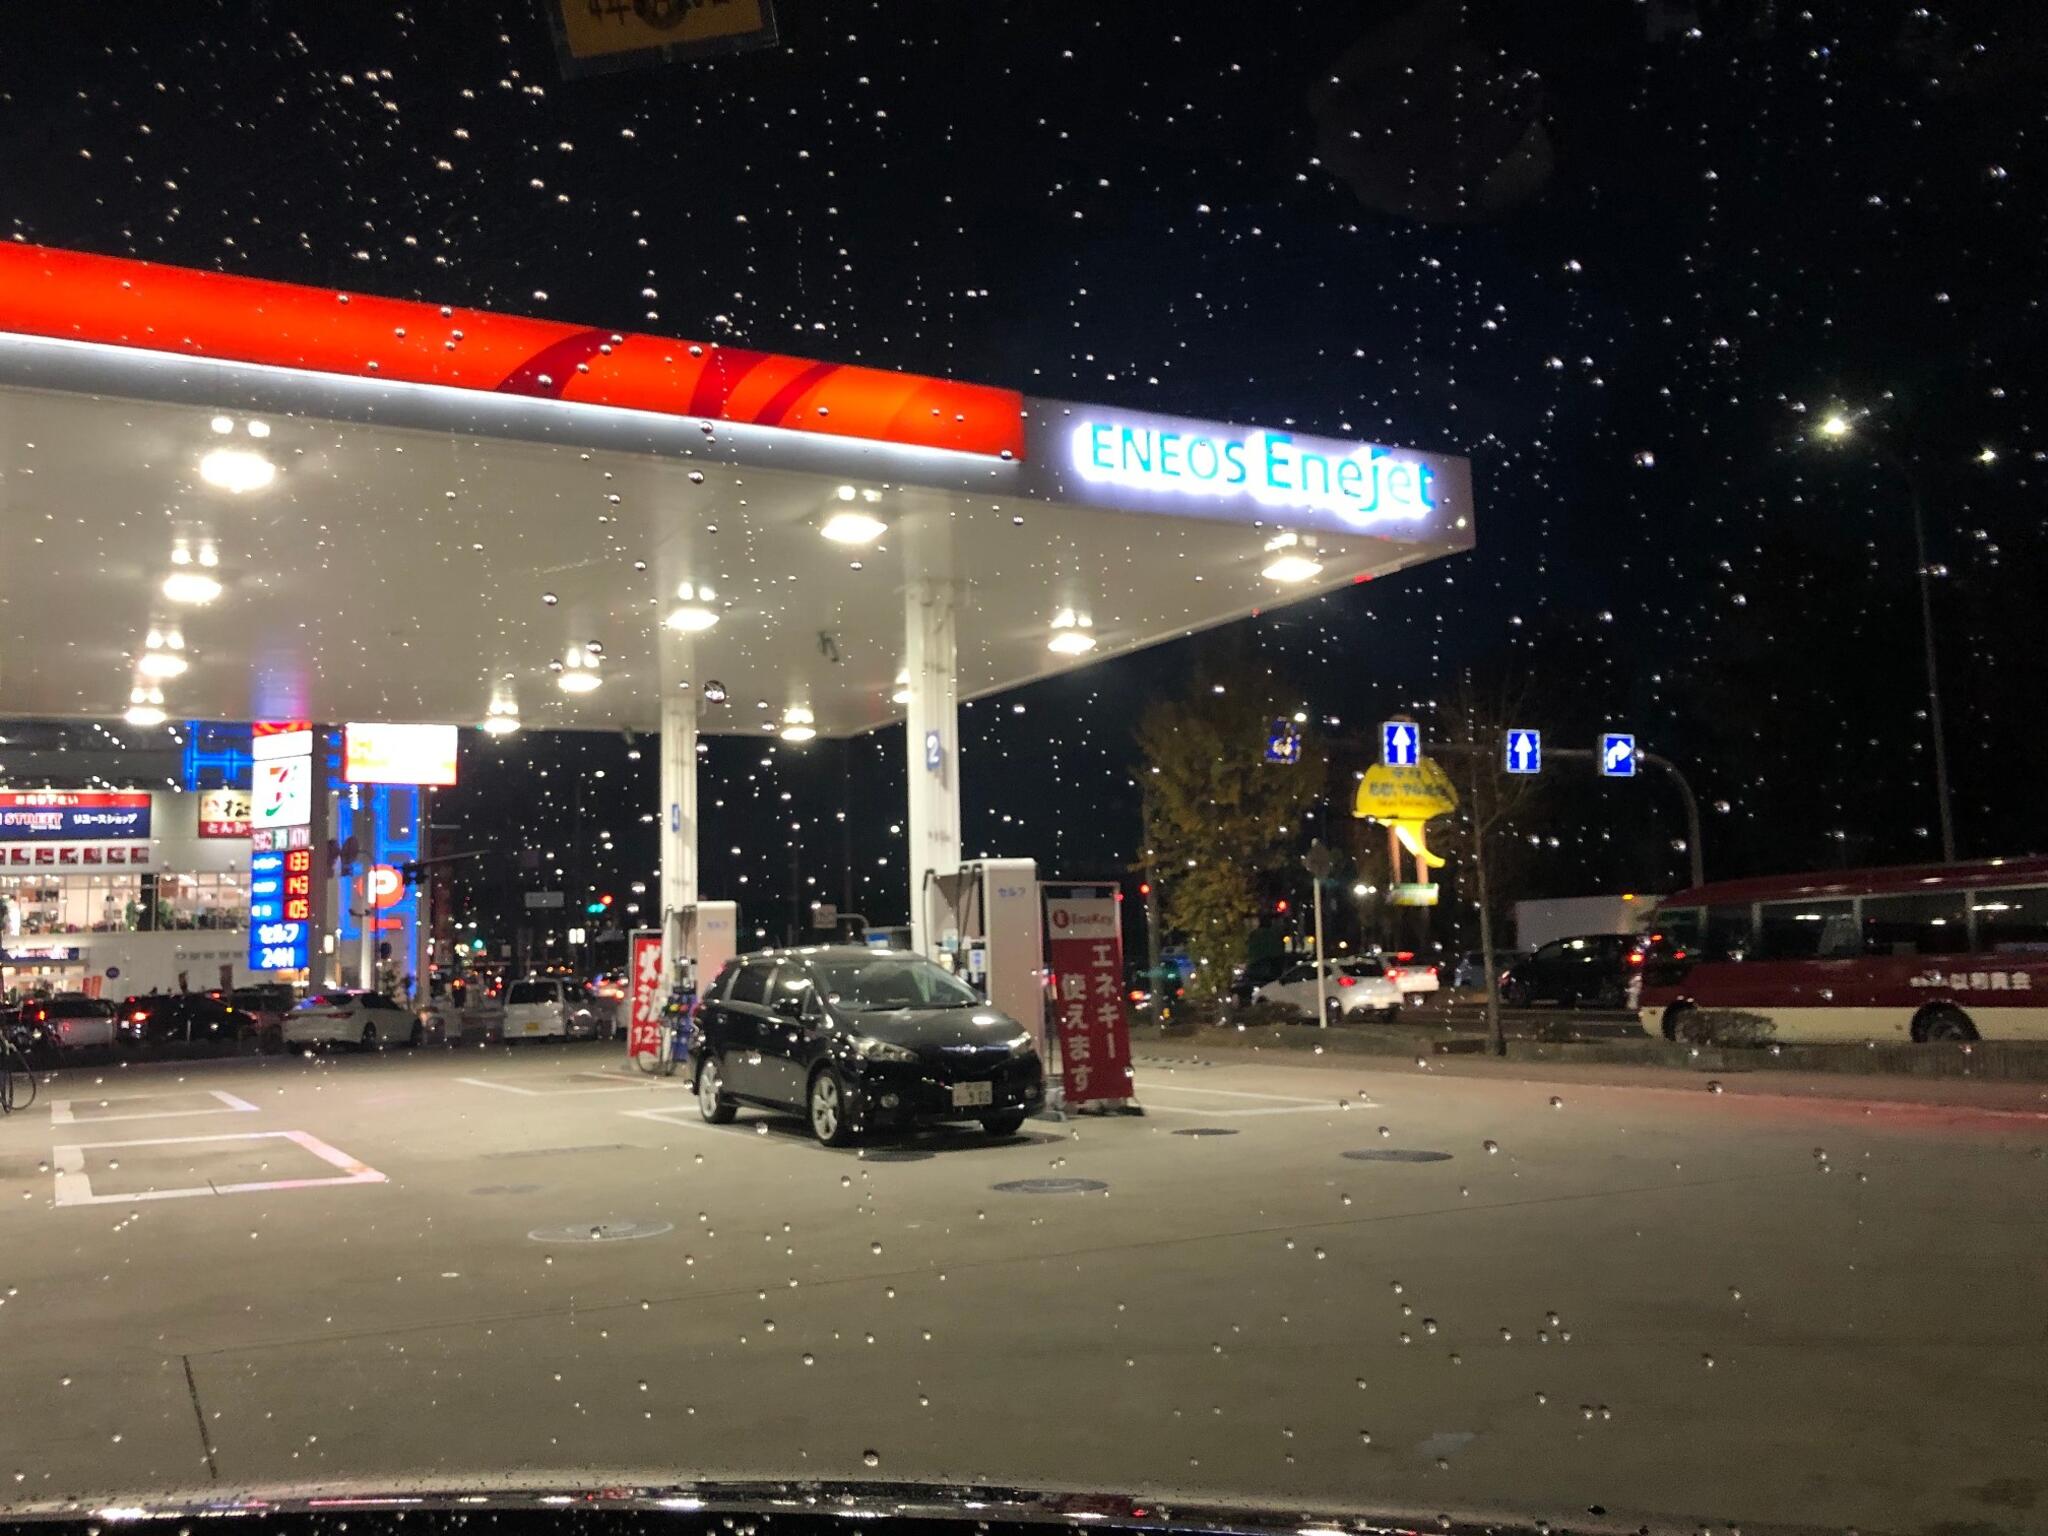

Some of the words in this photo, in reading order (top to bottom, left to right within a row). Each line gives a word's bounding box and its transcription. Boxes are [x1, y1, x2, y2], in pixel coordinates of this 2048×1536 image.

[1092, 423, 1246, 484] ENEOS
[207, 822, 252, 835] とんか
[258, 923, 300, 945] セルフ
[260, 947, 295, 969] 24H
[1061, 972, 1093, 1092] 使えます
